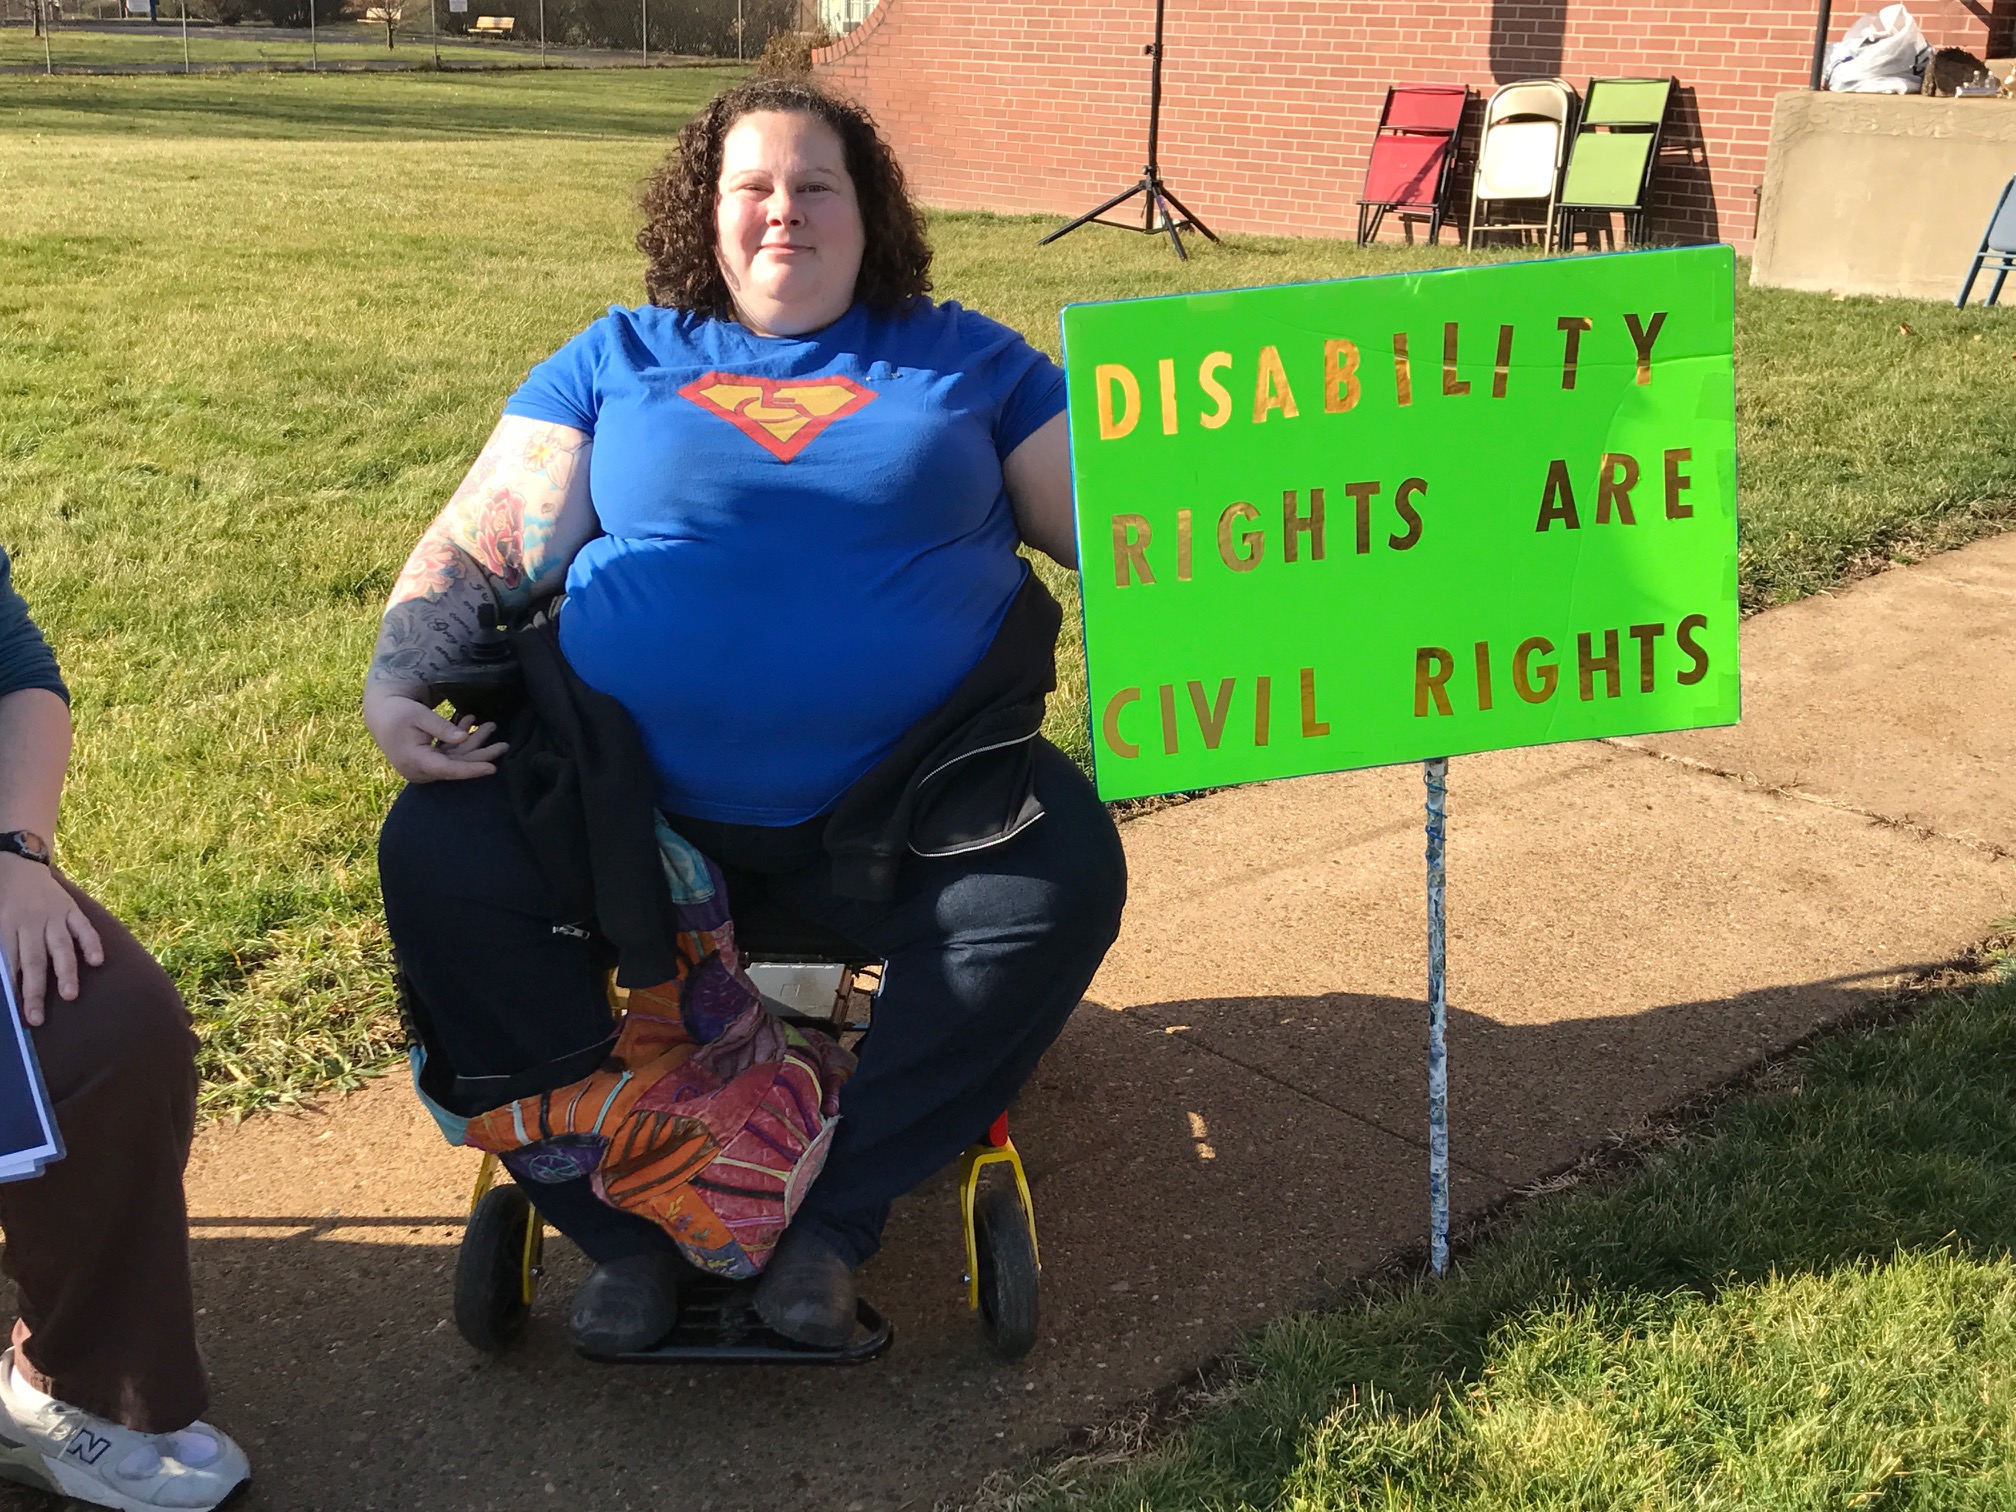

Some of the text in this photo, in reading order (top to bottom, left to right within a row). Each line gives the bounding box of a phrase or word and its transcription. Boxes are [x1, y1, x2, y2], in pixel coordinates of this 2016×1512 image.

[1095, 311, 1668, 441] DISABILITY
[1111, 447, 1694, 589] RIGHTS ARE
[1103, 614, 1709, 760] CIVIL RIGHTS
[66, 1429, 111, 1465] N
